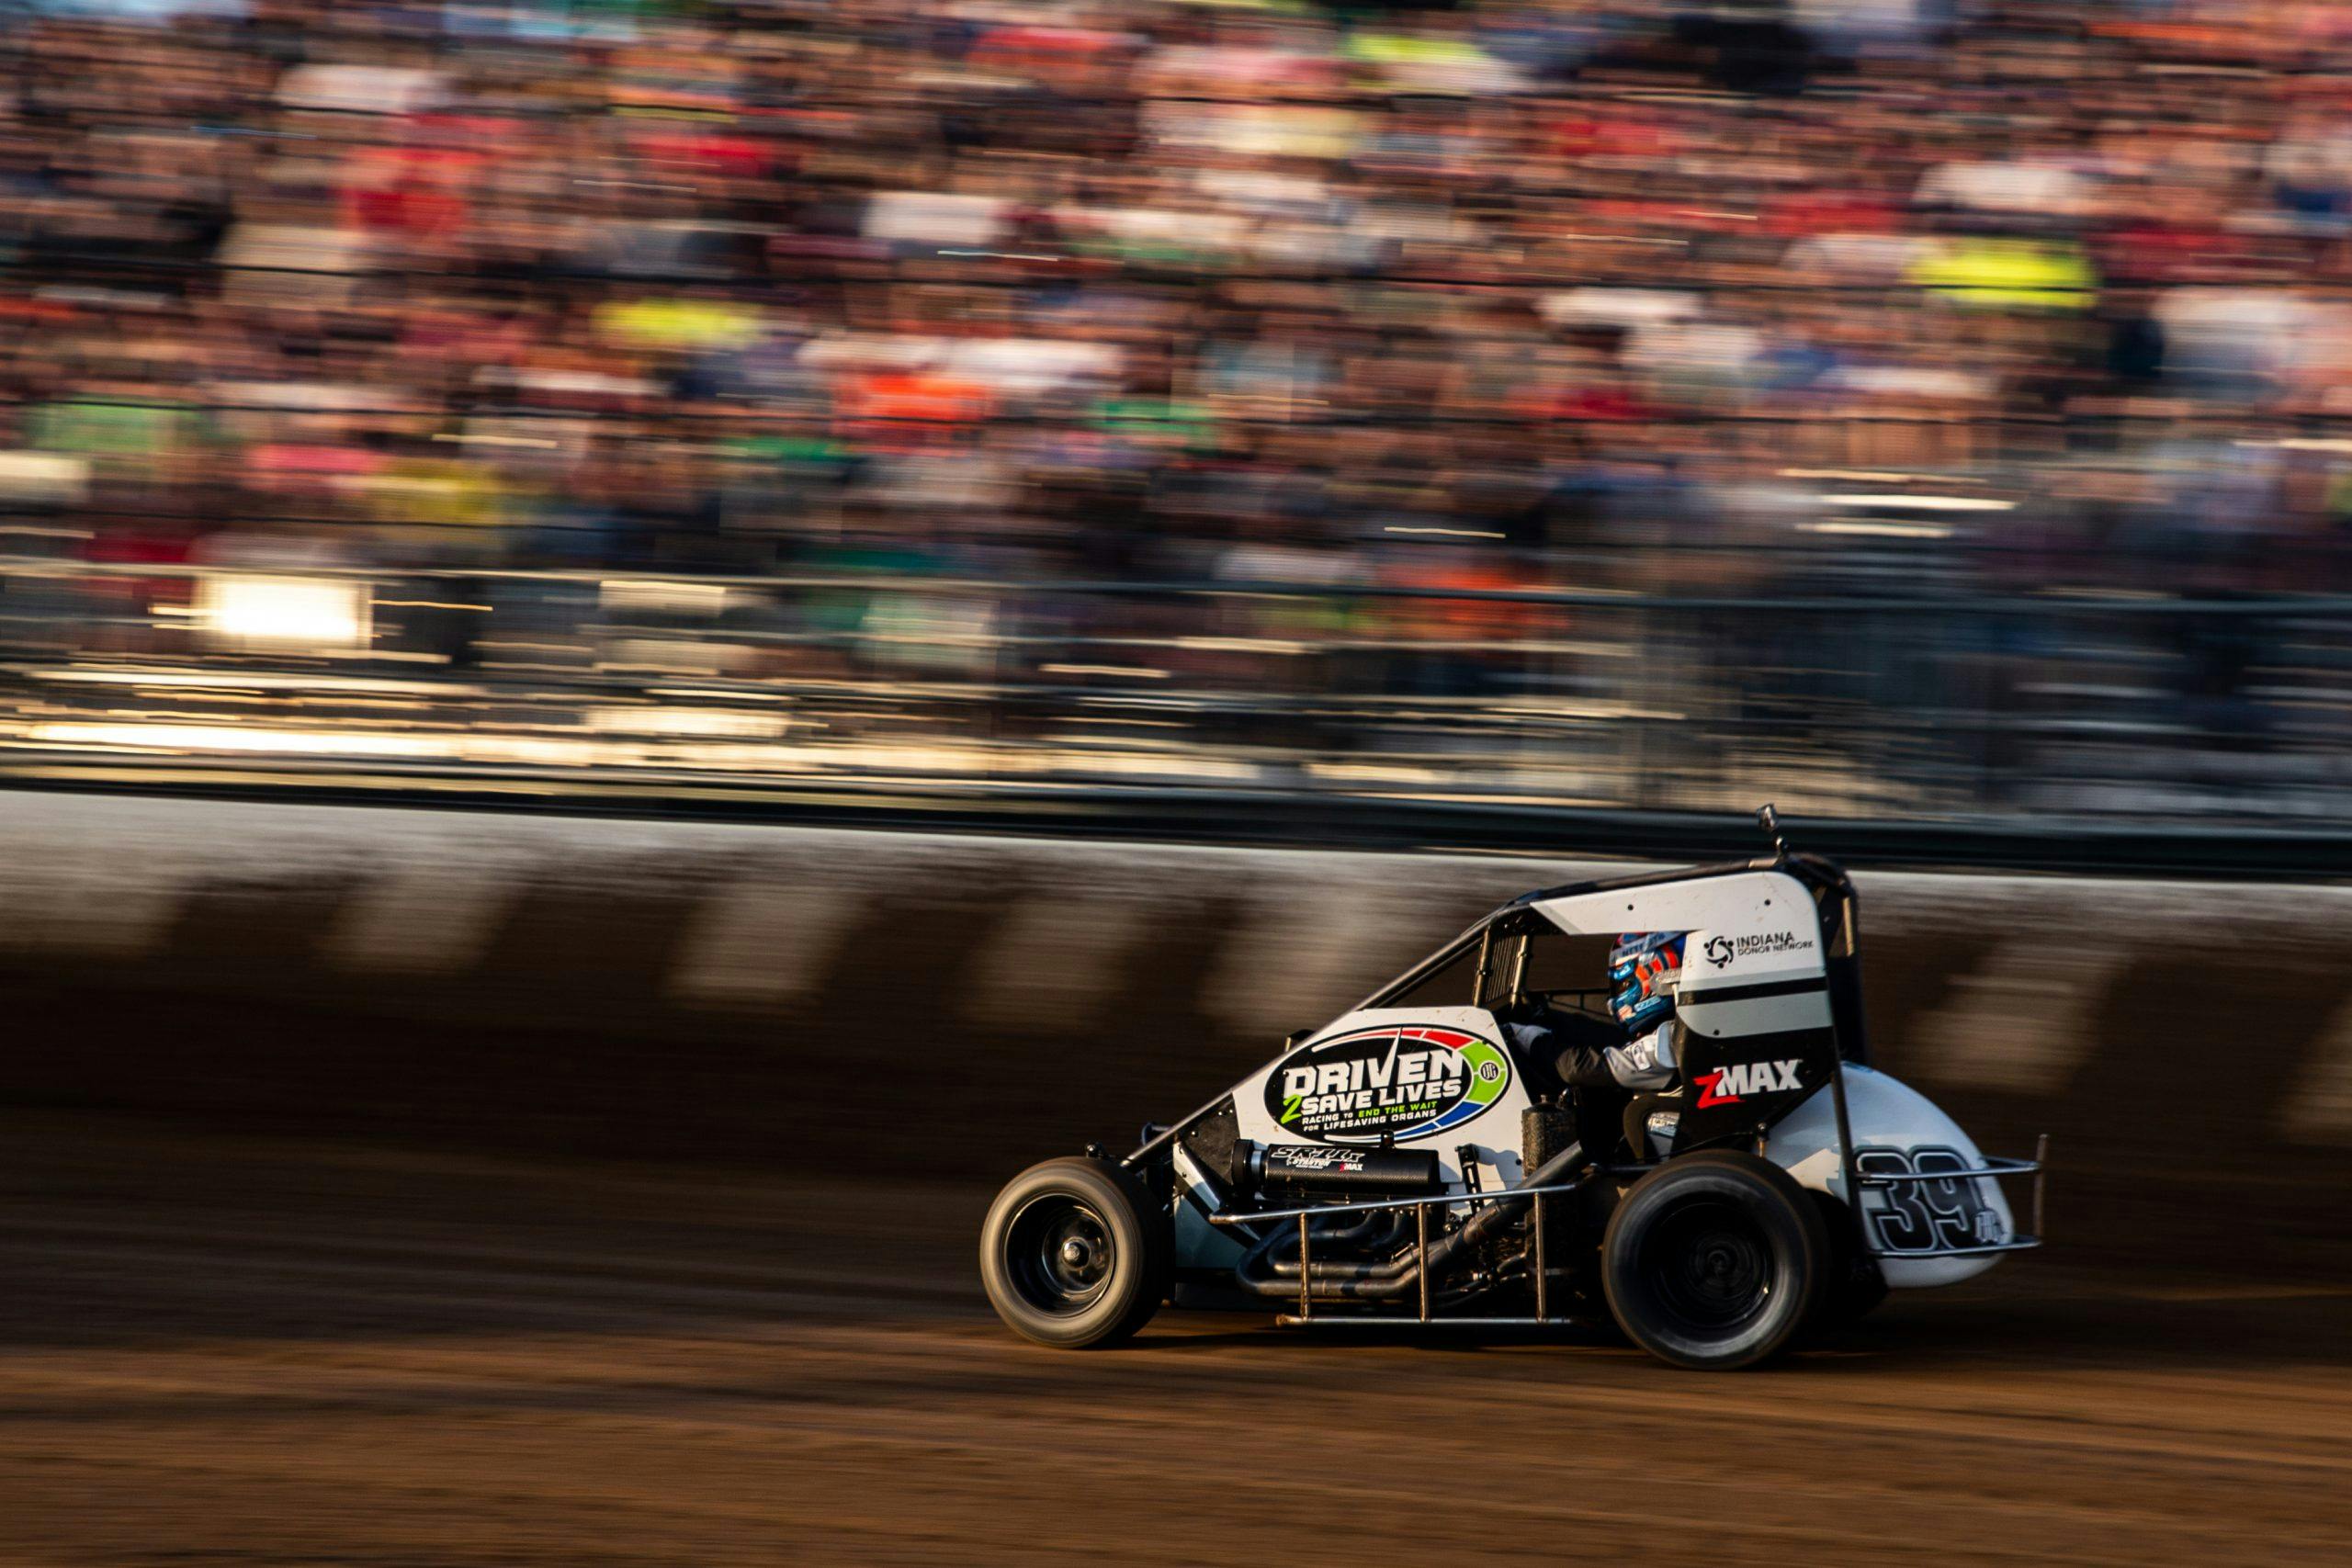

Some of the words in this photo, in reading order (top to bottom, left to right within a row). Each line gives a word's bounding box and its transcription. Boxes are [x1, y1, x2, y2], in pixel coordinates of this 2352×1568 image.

[1736, 931, 1794, 947] INDIANA
[1737, 945, 1770, 955] DONOR
[1773, 941, 1814, 952] NETWORK
[1283, 1046, 1464, 1099] DRIVEN
[1281, 1094, 1302, 1123] 2
[1301, 1089, 1373, 1115] SAVE
[1379, 1079, 1462, 1106] LIVES
[1302, 1113, 1339, 1125] RACING
[1359, 1108, 1380, 1118] END
[1385, 1104, 1406, 1114] THE
[1409, 1100, 1438, 1112] WAIT
[1323, 1116, 1386, 1131] LIFESAVING
[1391, 1109, 1437, 1122] ORGANS
